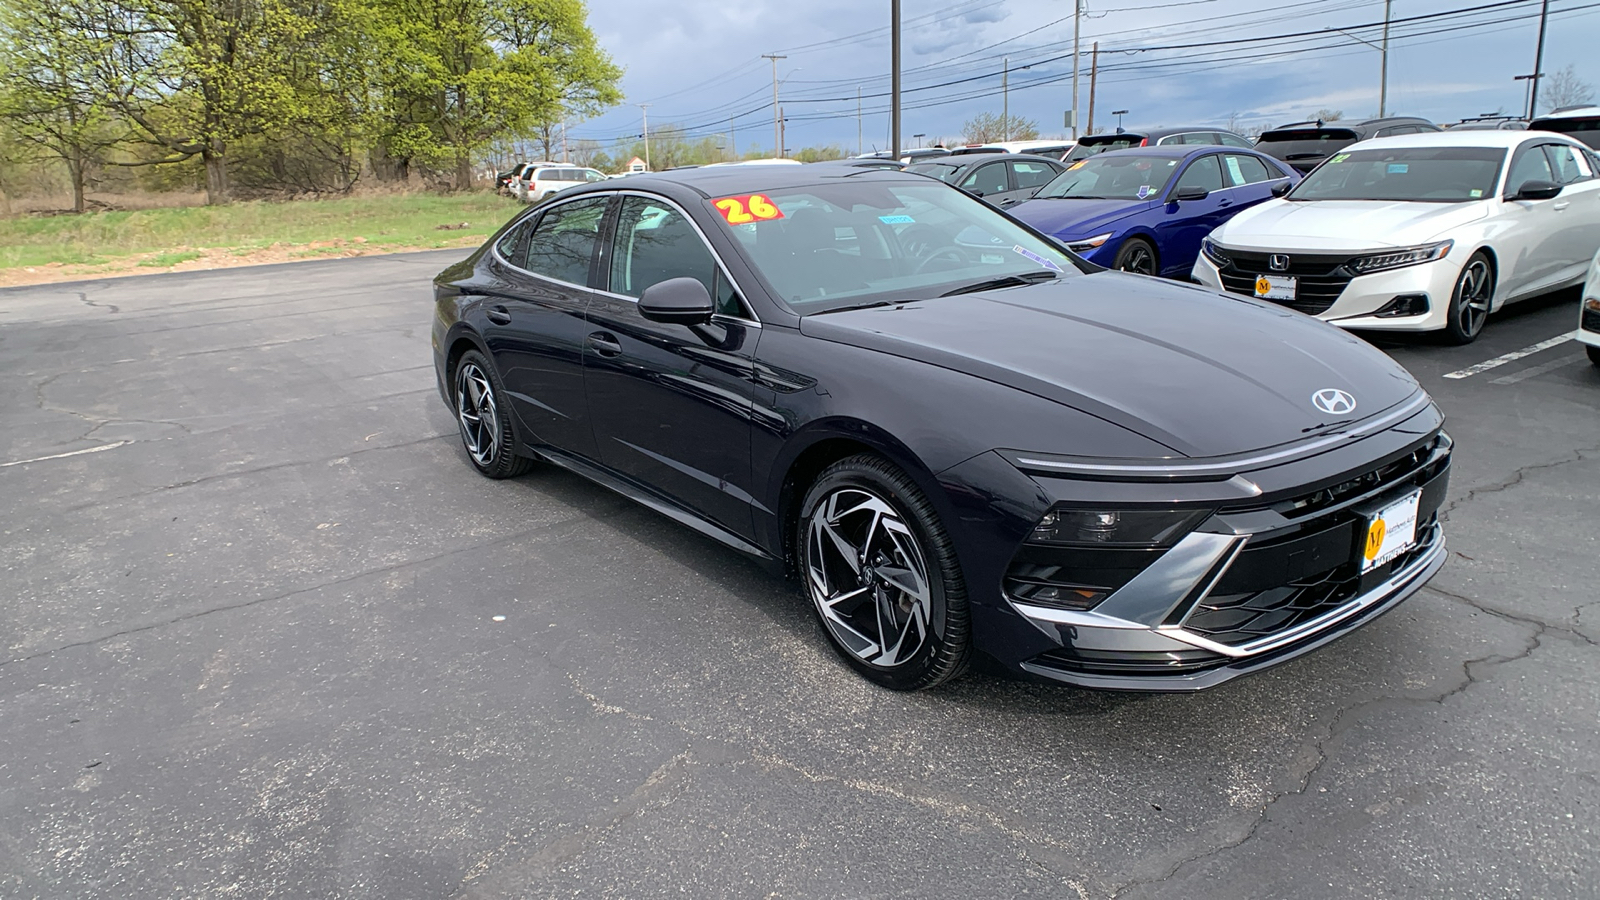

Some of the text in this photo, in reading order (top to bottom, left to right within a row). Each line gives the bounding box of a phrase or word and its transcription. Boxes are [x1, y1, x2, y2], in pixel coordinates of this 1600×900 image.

[715, 194, 778, 224] 26
[1259, 282, 1268, 290] M
[1367, 526, 1383, 552] M
[1374, 543, 1407, 569] MATTHEWS
